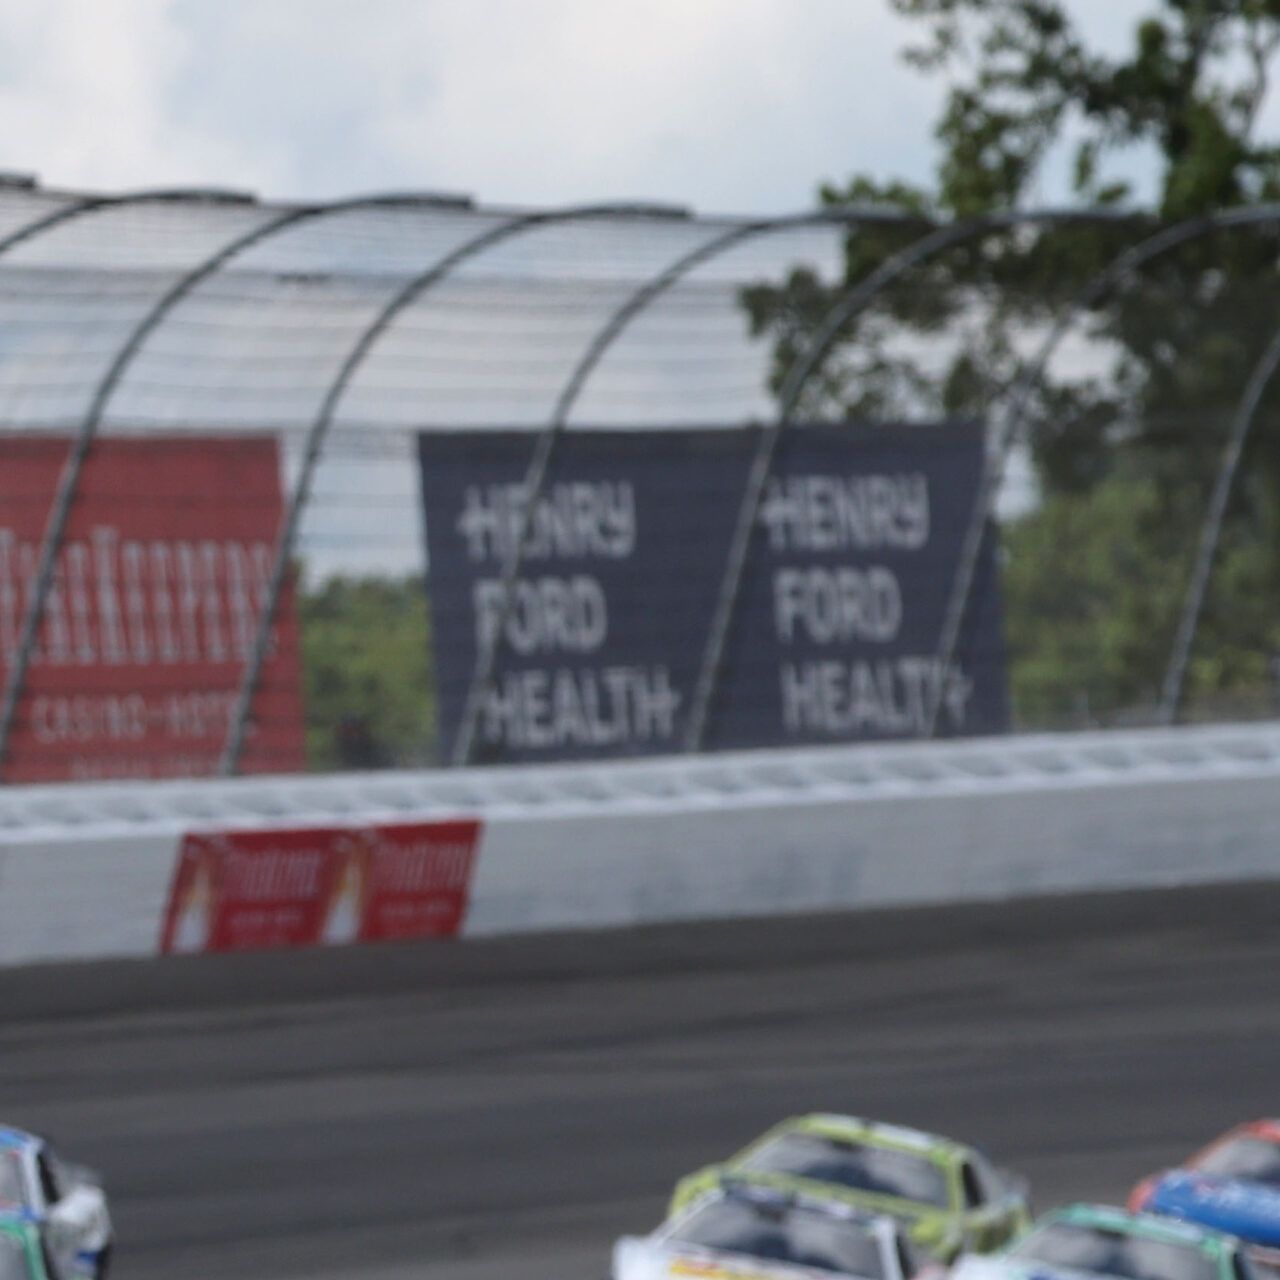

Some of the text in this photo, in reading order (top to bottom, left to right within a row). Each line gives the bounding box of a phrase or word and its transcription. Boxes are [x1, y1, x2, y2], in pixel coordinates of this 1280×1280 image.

[458, 480, 636, 563] HENRY
[758, 472, 930, 552] HENRY
[472, 574, 608, 654] FORD
[773, 565, 904, 643] FORD
[484, 664, 680, 749] HEALTH
